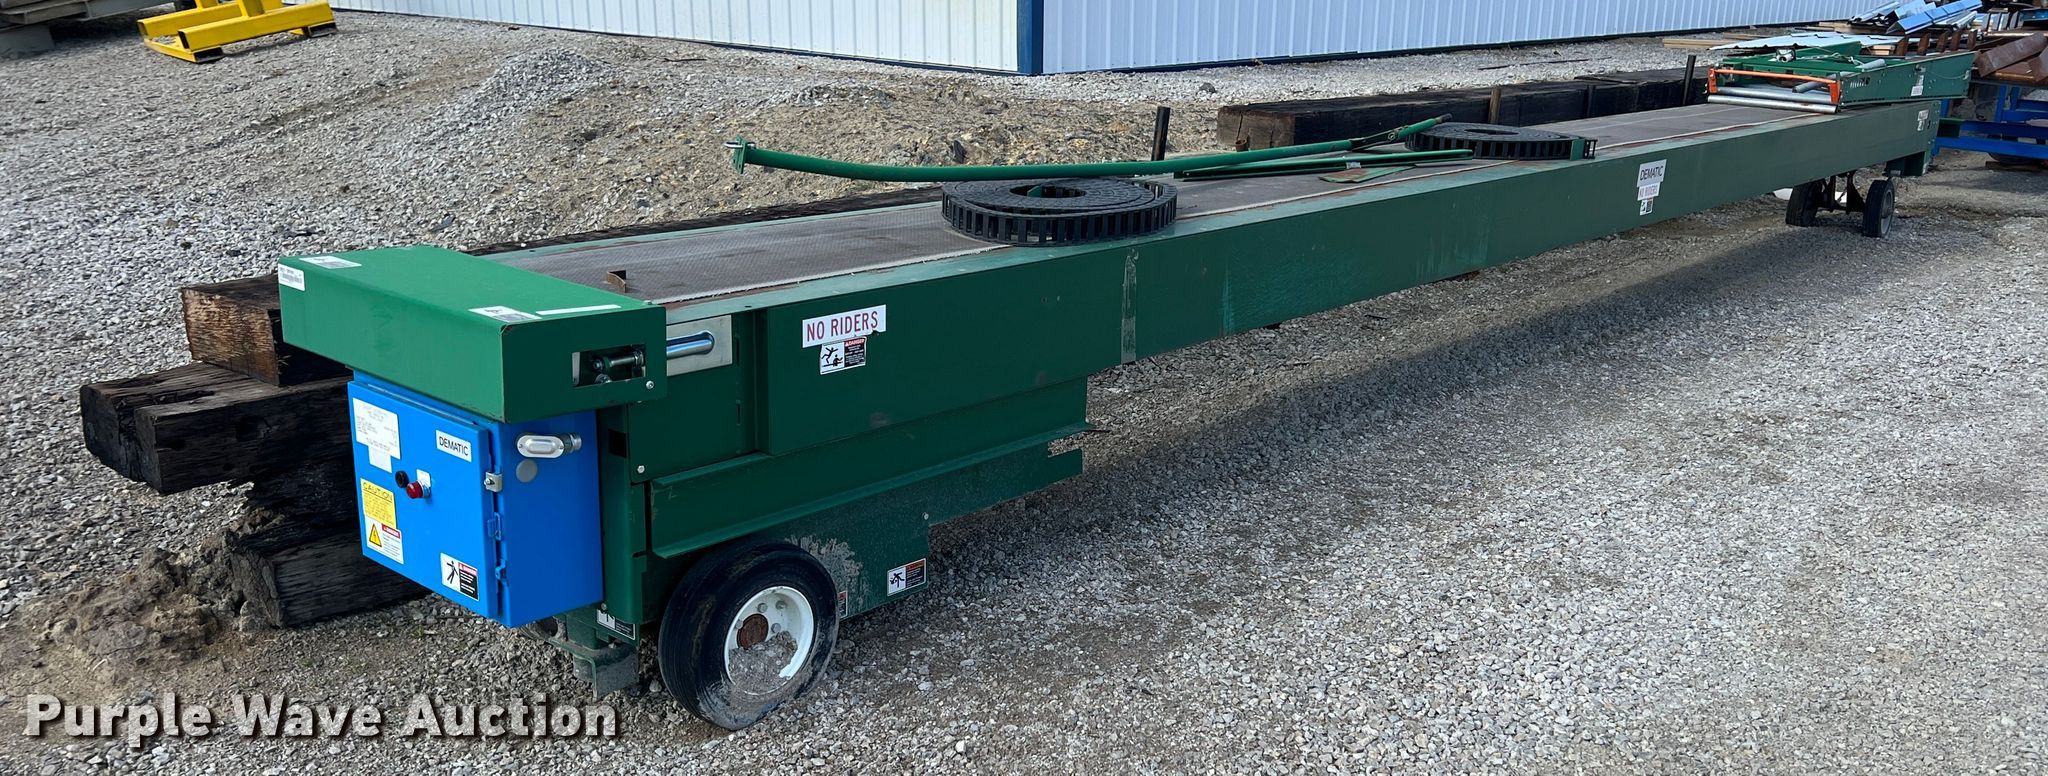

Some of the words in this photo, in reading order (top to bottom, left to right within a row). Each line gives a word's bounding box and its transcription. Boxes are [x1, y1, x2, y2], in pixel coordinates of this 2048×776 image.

[1640, 166, 1664, 180] DEMATIC
[807, 321, 825, 342] NO
[831, 311, 878, 337] RIDERS
[439, 436, 469, 457] DEMATIC
[362, 482, 393, 501] CAUTION
